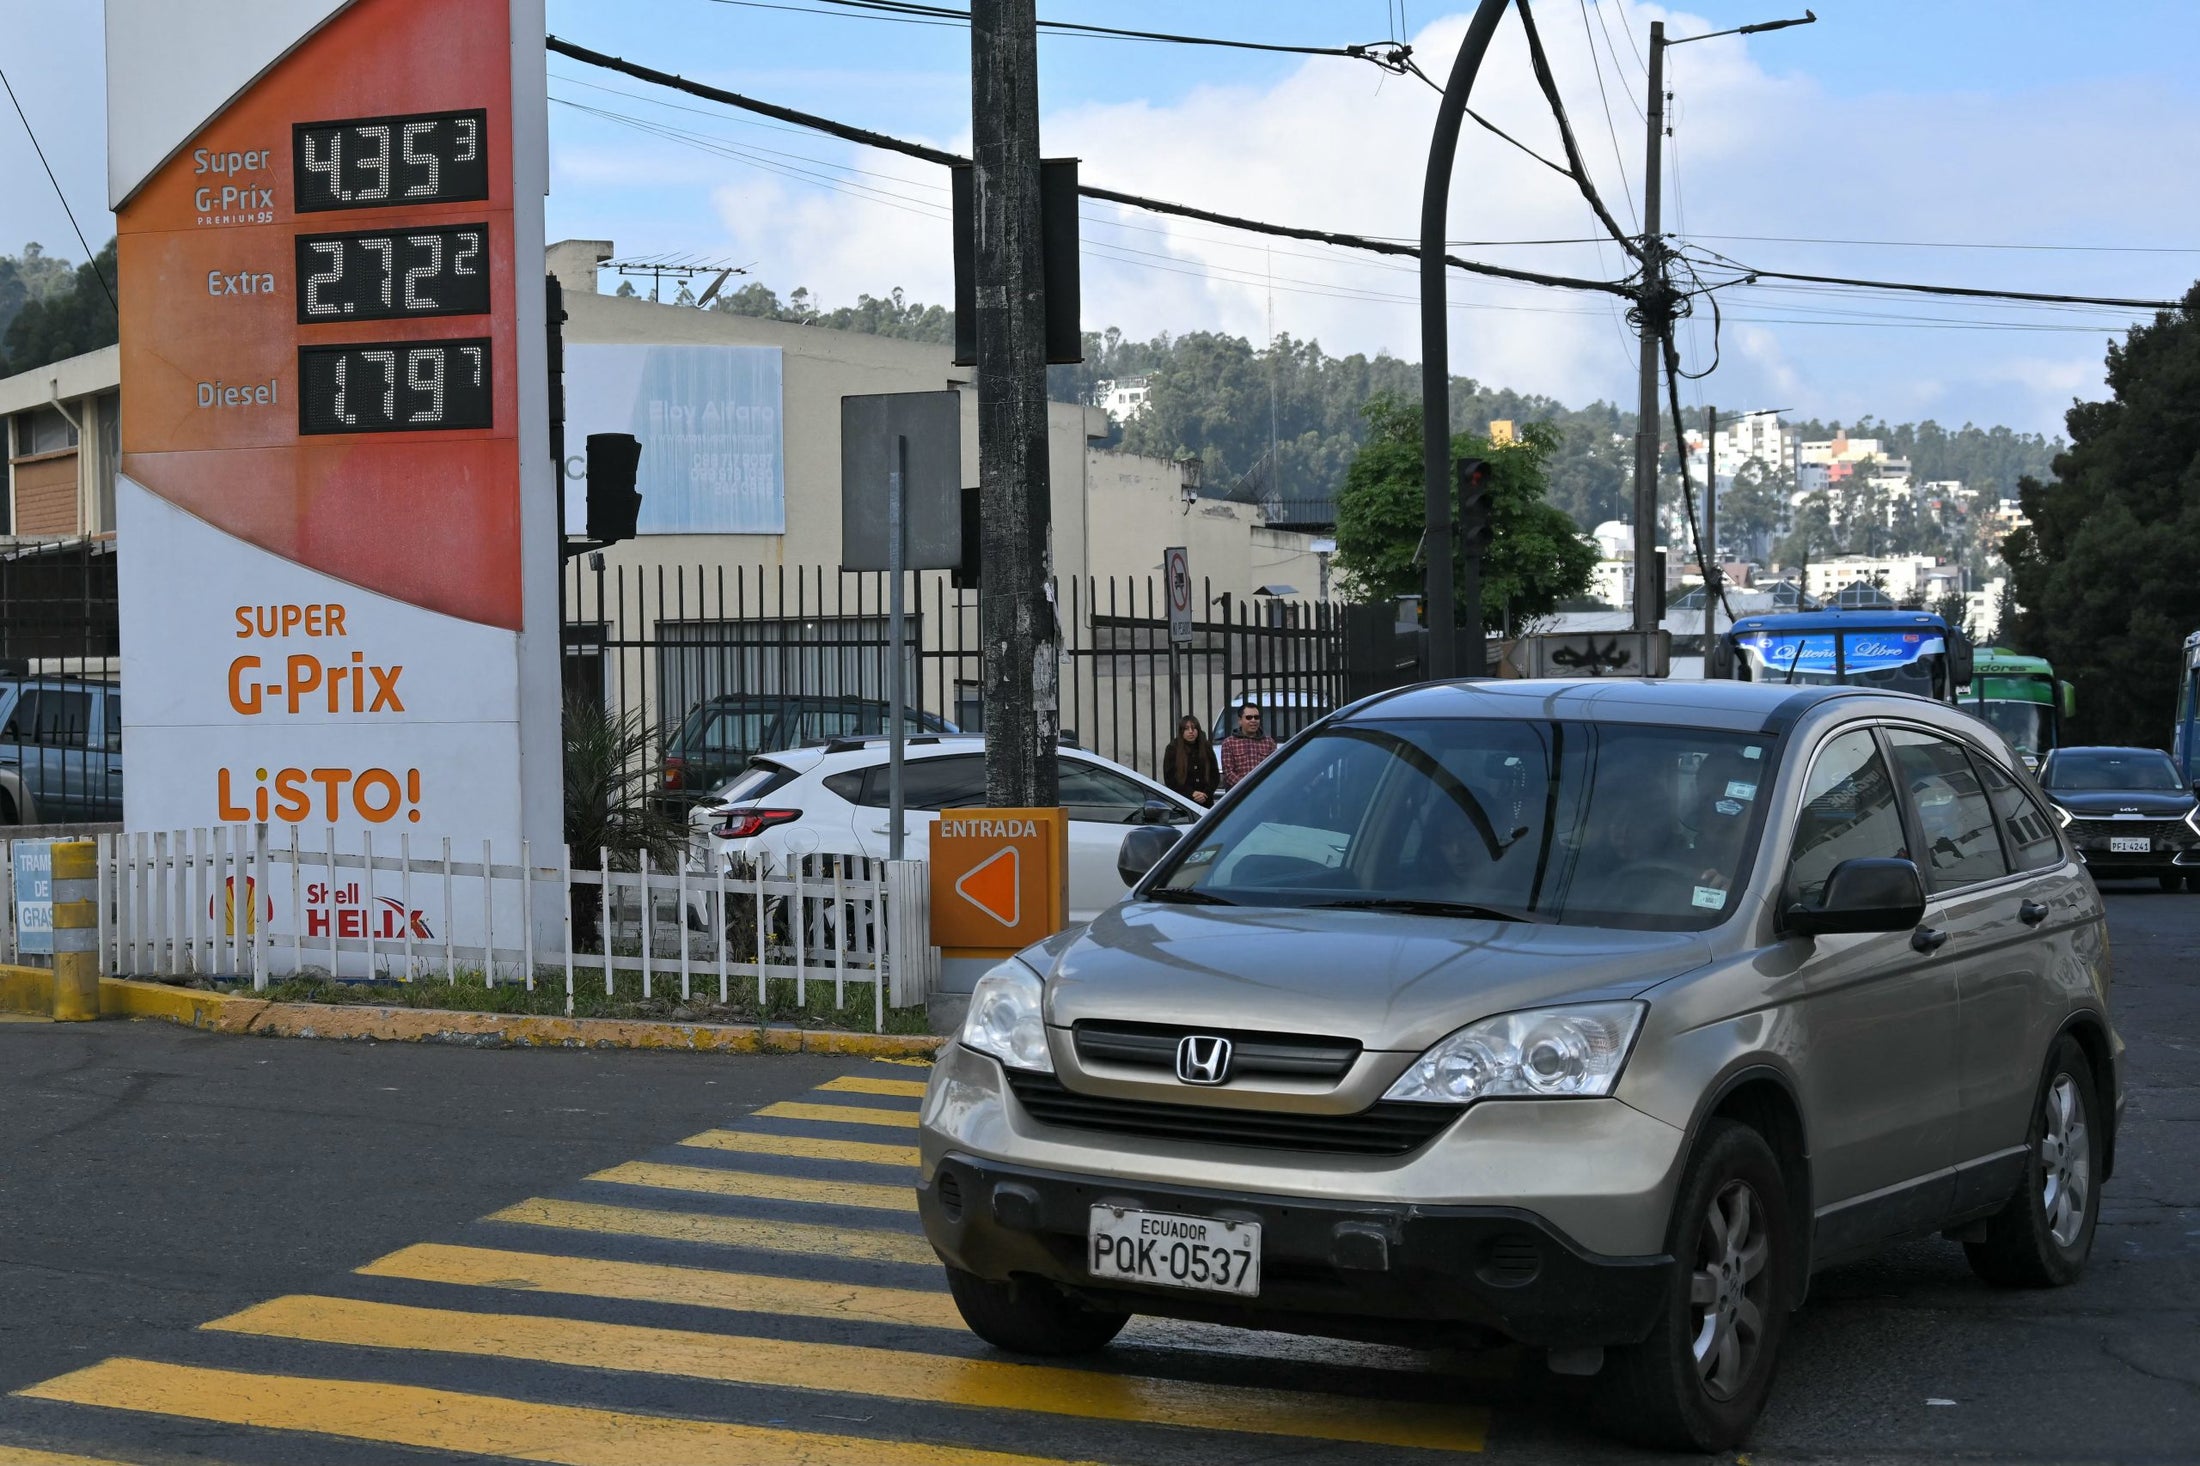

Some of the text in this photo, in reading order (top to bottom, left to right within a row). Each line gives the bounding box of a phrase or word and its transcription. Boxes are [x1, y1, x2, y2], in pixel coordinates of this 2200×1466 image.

[193, 149, 270, 177] Super
[195, 184, 274, 212] G-Prix
[197, 214, 255, 225] PREMIUM
[208, 271, 275, 296] Extra
[197, 380, 278, 408] Diesel
[235, 604, 347, 639] SUPER
[1852, 642, 1903, 657] Libre
[228, 651, 405, 716] G-Prix
[941, 820, 1037, 838] ENTRADA
[34, 880, 49, 897] DE
[307, 882, 359, 905] Shell
[306, 908, 431, 939] HELIX
[1141, 1218, 1207, 1241] ECUADOR
[1094, 1232, 1252, 1288] PQK-0537
